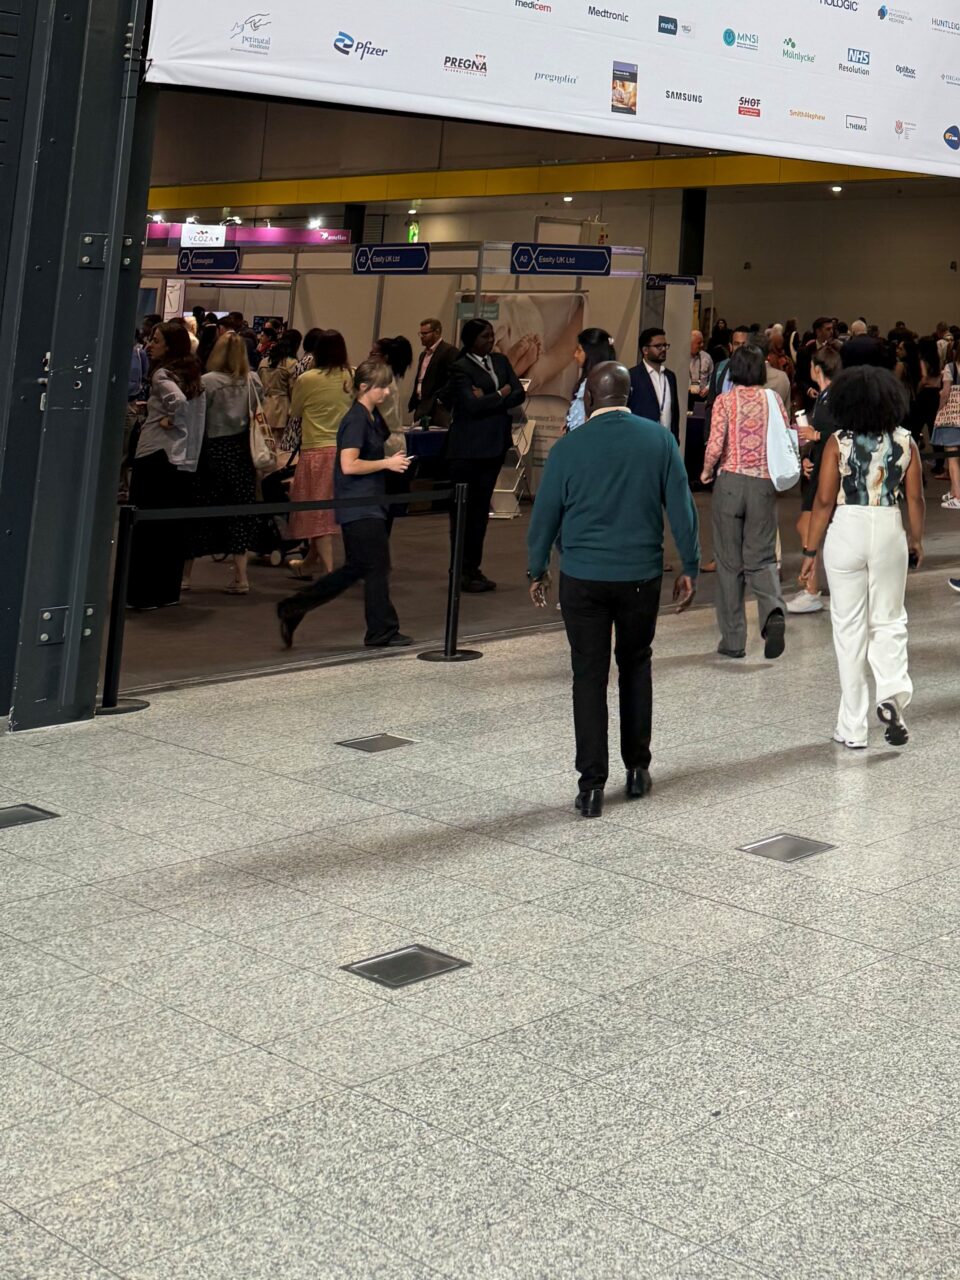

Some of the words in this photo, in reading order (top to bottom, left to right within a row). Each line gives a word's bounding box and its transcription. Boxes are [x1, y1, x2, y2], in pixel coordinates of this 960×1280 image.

[515, 0, 551, 13] medicem
[588, 6, 628, 22] Medtronic
[242, 36, 270, 45] perinatal
[355, 40, 388, 60] Pfizer
[849, 49, 869, 64] NHS
[444, 56, 487, 71] PREGNA
[839, 63, 870, 76] Resolution
[665, 90, 703, 103] SAMSUNG
[739, 97, 761, 107] SHOT
[539, 256, 555, 264] Essity
